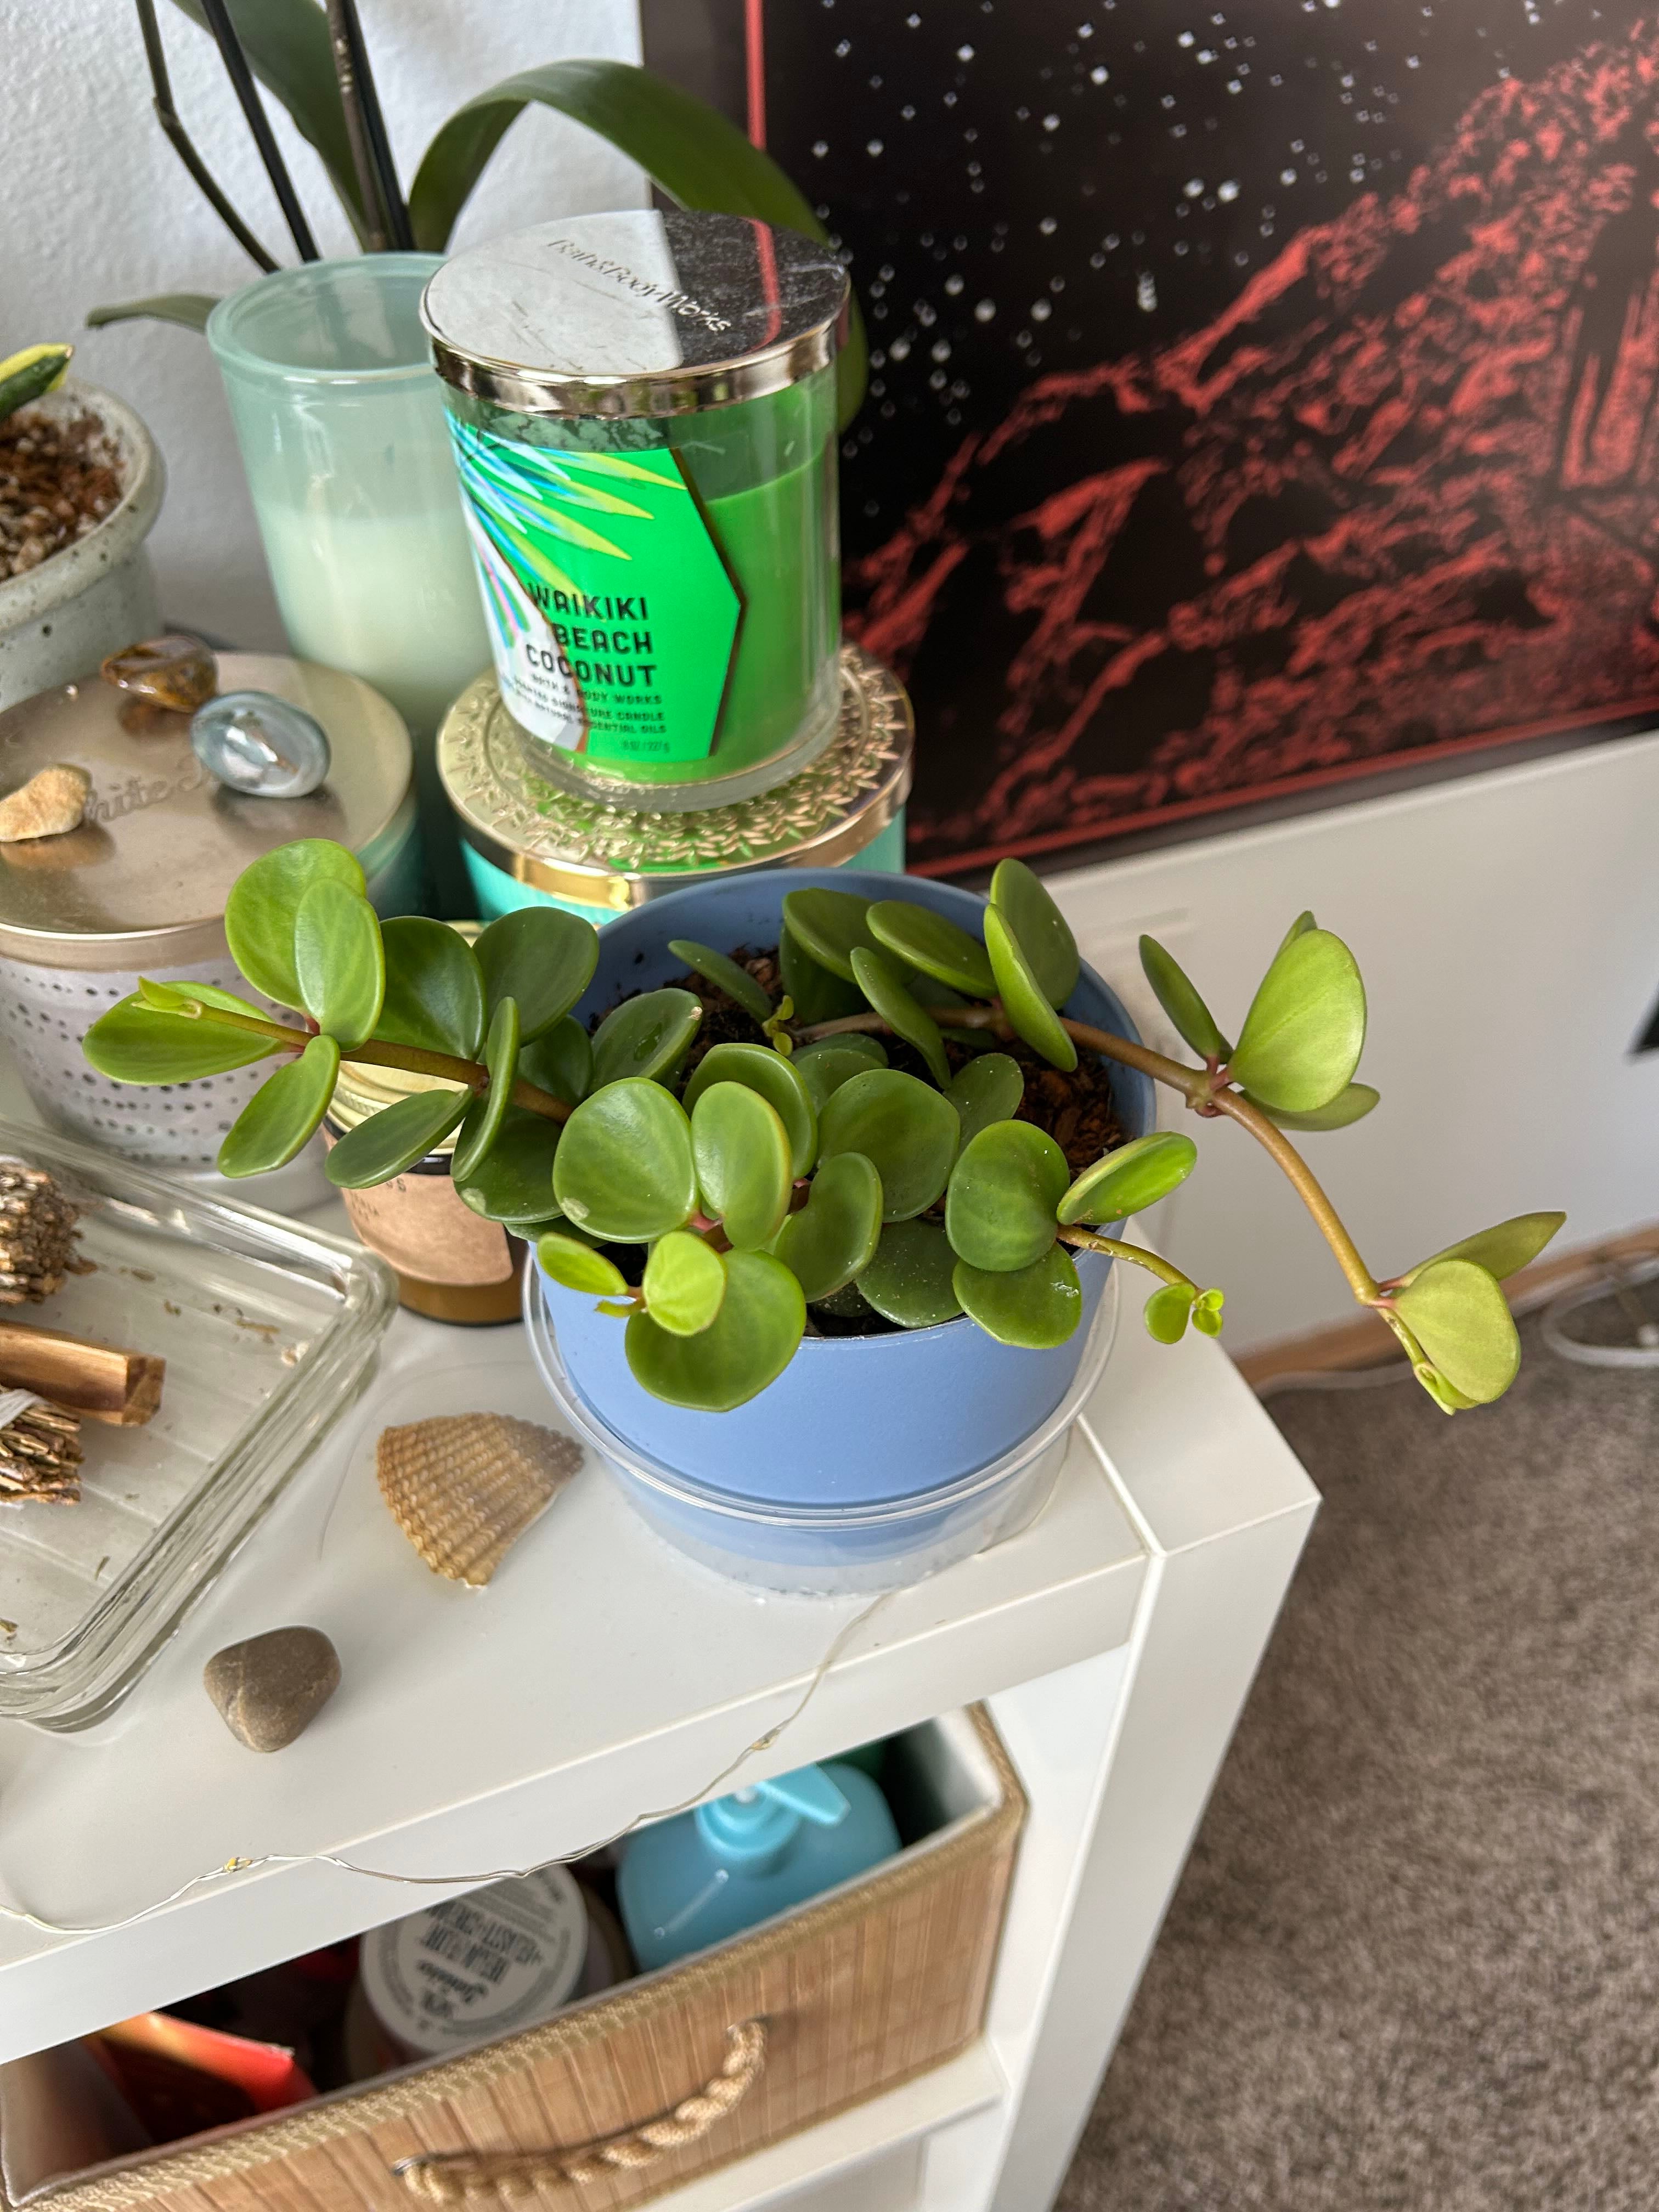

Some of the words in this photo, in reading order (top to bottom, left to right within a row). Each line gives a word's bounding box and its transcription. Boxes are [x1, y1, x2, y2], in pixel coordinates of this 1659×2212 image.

[528, 582, 649, 620] WAIKIKI
[552, 622, 653, 654] BEACH
[526, 644, 657, 687] COCONUT
[576, 688, 608, 703] BODY
[613, 693, 663, 706] WORKS
[615, 712, 665, 722] CANDLE
[640, 724, 668, 735] OILS
